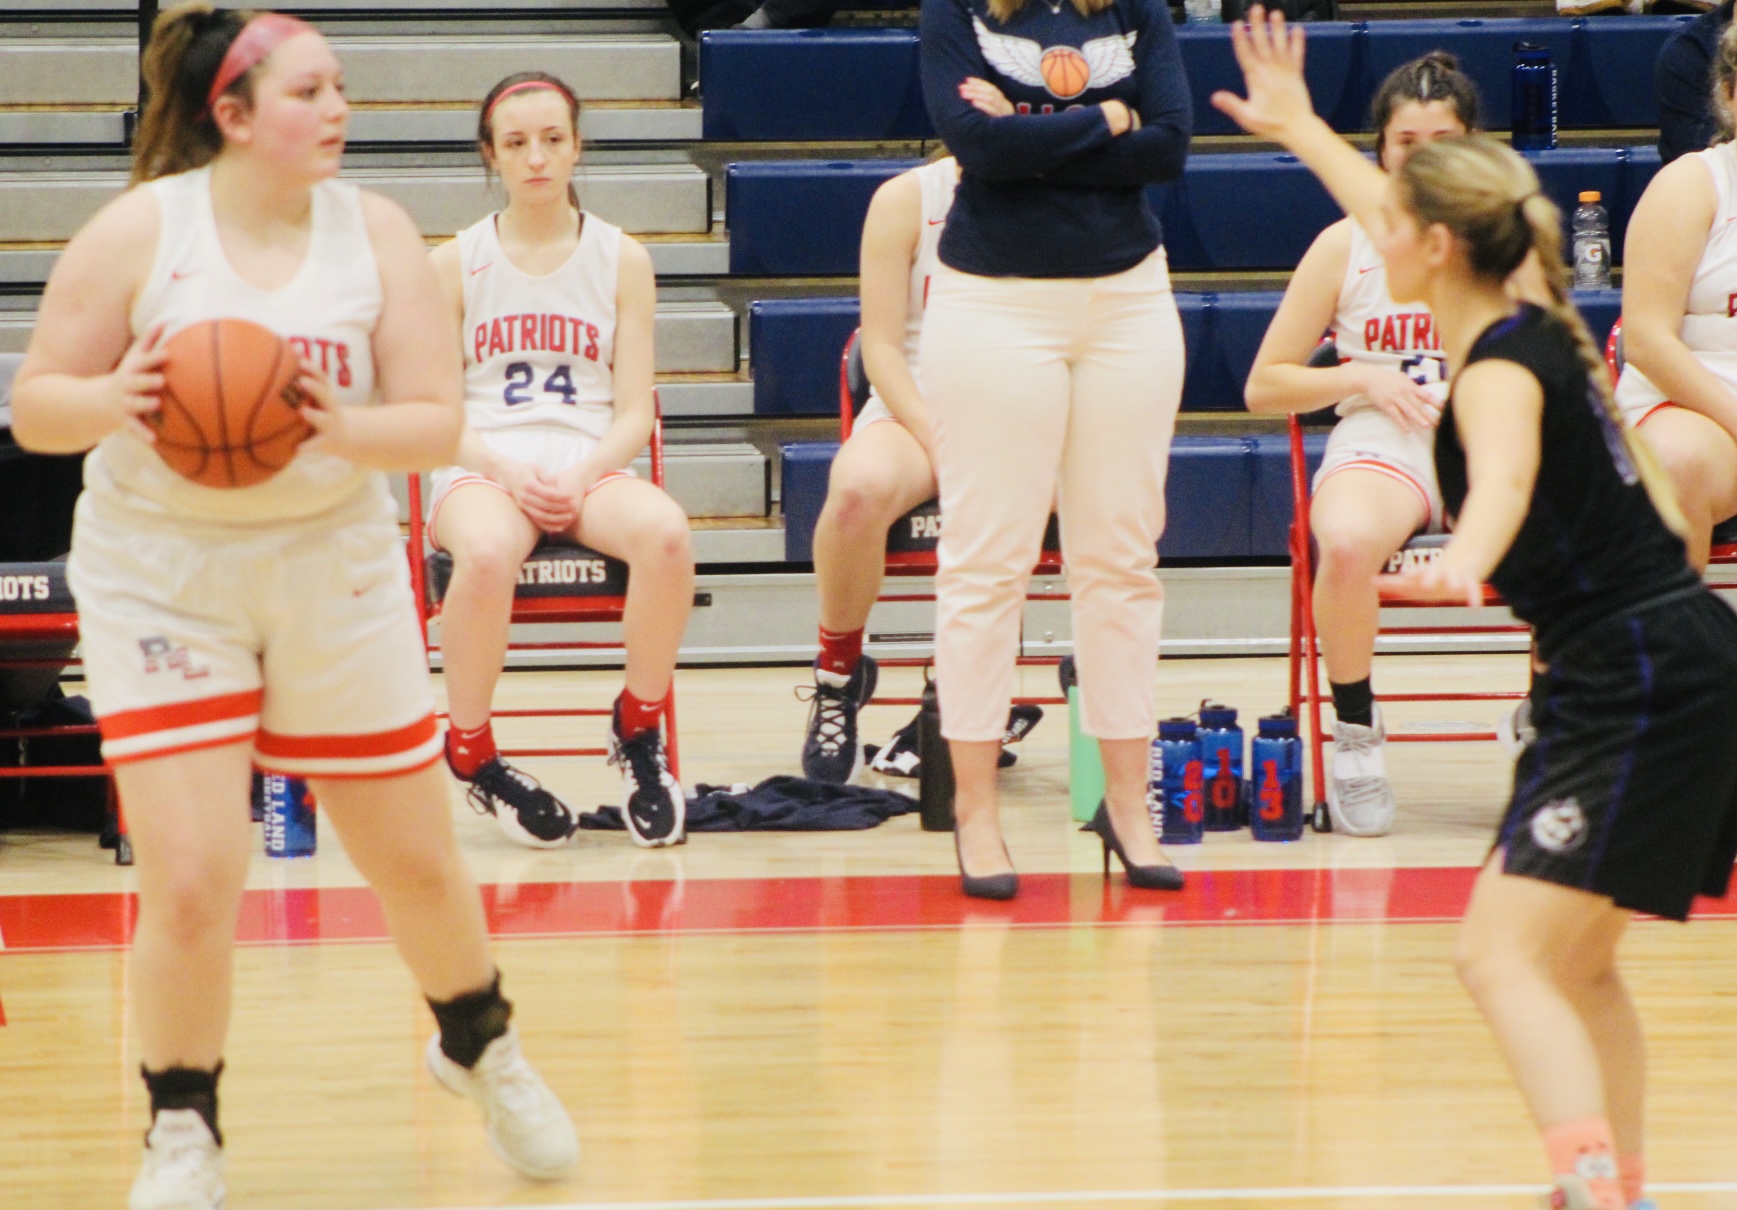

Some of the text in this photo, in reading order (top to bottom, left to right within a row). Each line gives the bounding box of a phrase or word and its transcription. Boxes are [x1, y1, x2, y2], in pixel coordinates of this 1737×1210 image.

[1585, 243, 1602, 262] G
[474, 313, 600, 364] PATRIOTS
[503, 361, 577, 406] 24
[1212, 748, 1236, 808] 10
[271, 801, 286, 851] LAND
